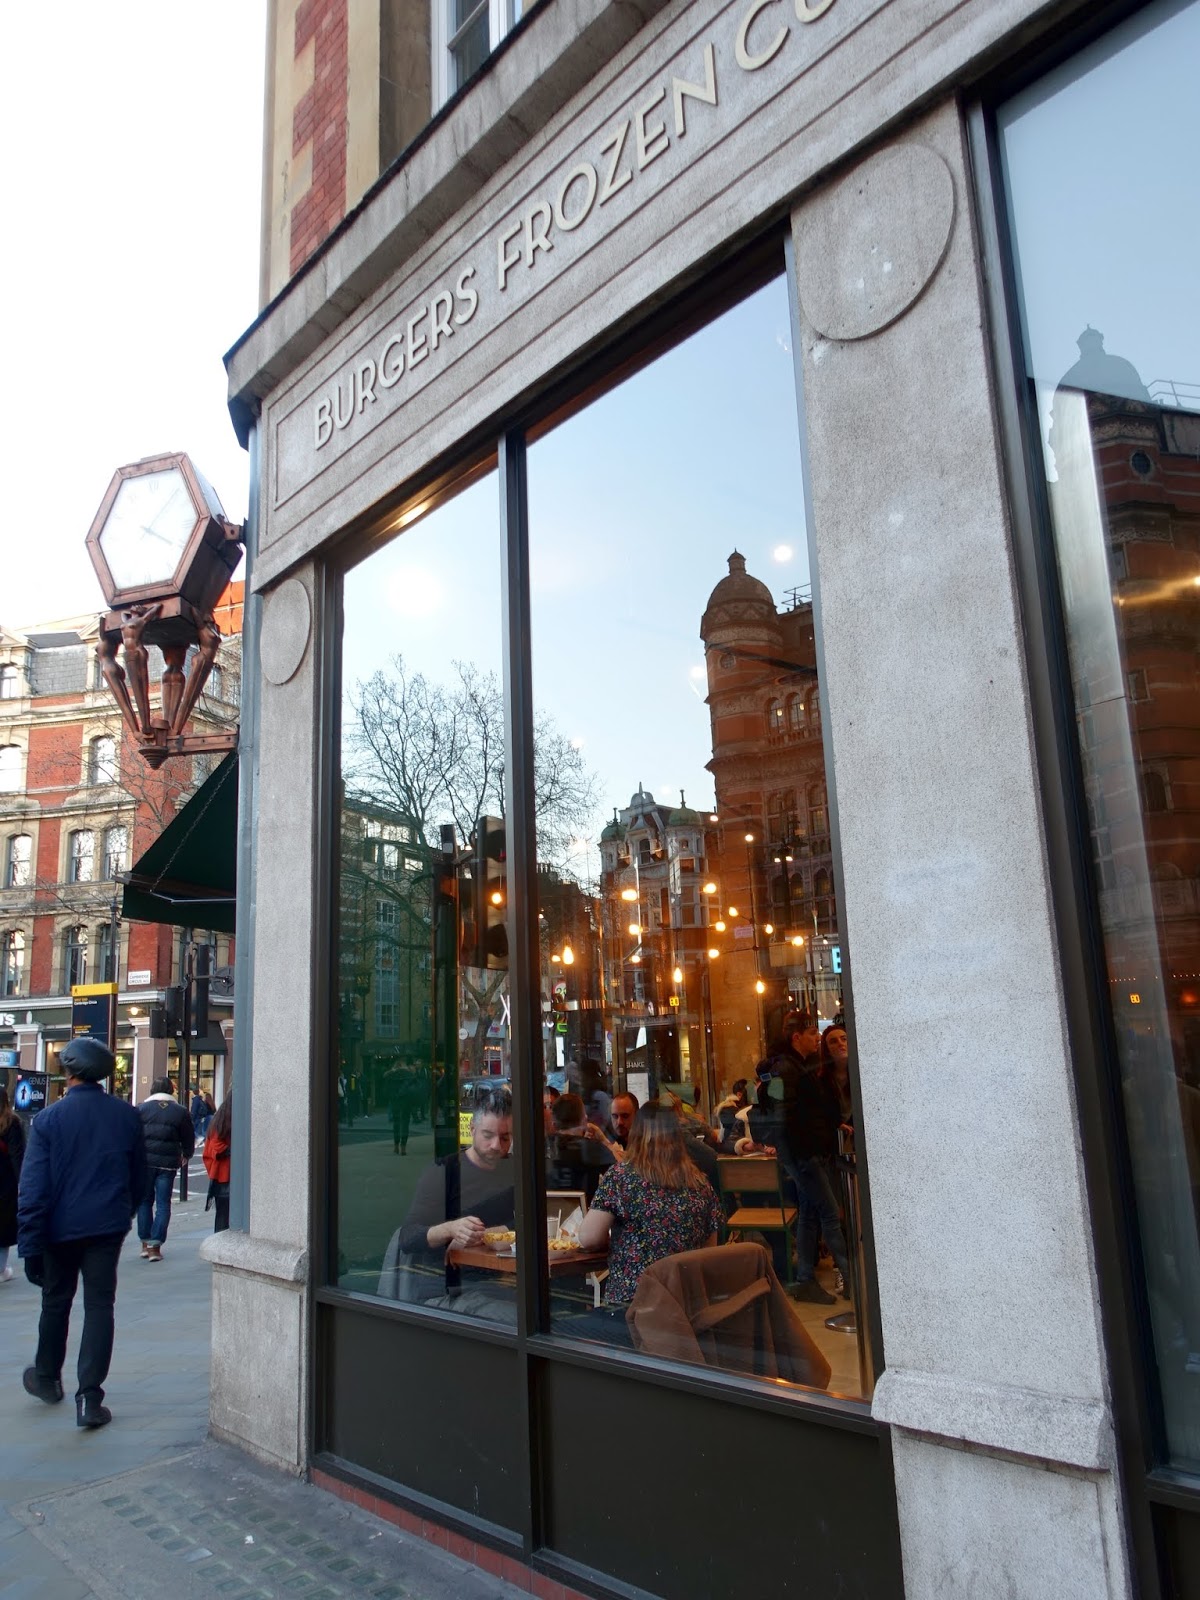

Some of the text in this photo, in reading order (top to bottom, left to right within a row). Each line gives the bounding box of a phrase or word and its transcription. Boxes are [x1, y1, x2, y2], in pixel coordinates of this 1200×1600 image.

[313, 0, 837, 451] BURGERS FROZEN C
